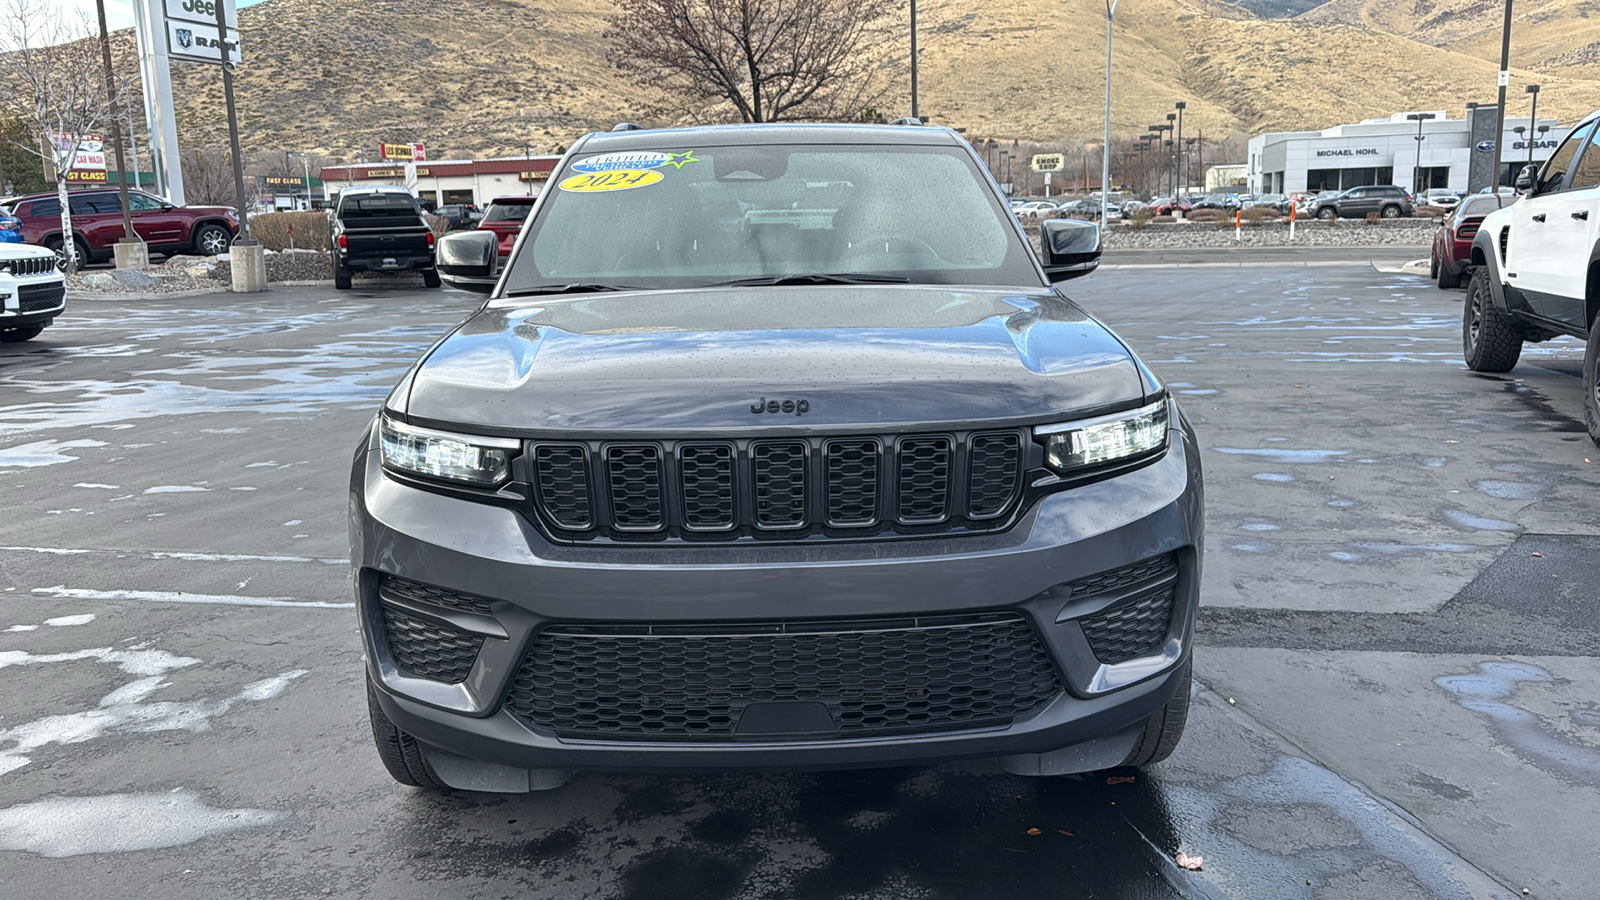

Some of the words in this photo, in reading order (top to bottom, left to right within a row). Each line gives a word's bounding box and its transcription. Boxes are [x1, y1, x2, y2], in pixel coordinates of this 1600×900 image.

[182, 0, 217, 16] Jee
[1317, 149, 1354, 157] MICHAEL
[76, 155, 87, 164] CAR
[88, 156, 103, 164] WASH
[585, 154, 664, 164] CERTIFIED
[81, 172, 106, 180] CLASS
[572, 172, 651, 188] 2024
[750, 397, 810, 416] Jeep
